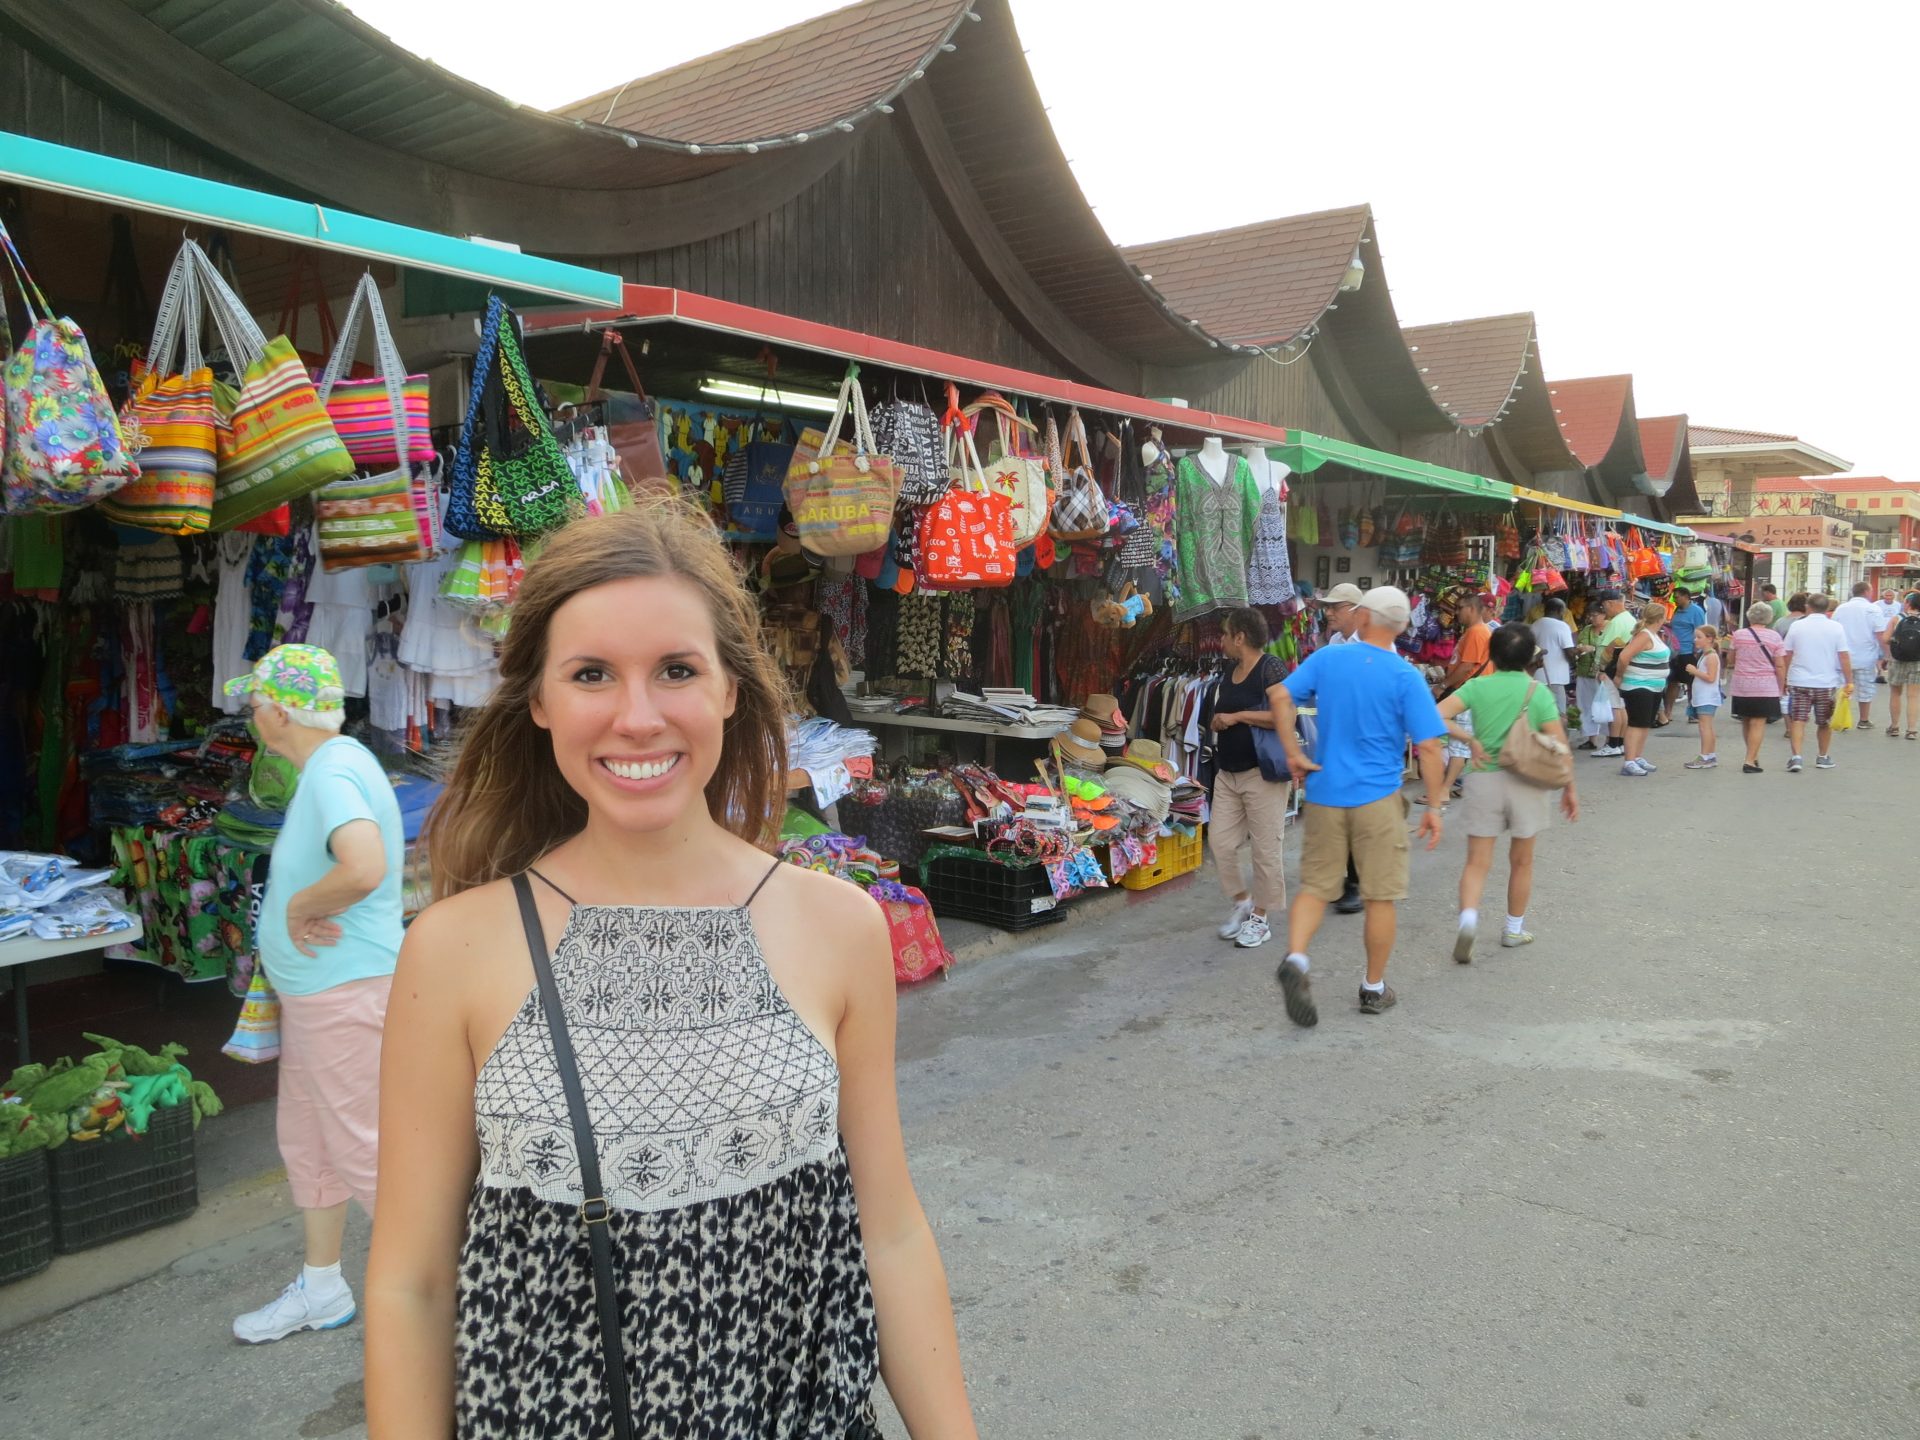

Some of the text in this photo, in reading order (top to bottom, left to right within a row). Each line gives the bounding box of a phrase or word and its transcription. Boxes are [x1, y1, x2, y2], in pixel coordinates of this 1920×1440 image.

[921, 434, 937, 491] ARUBA
[521, 480, 559, 505] ARUBA
[807, 503, 870, 521] ARUBA
[1762, 524, 1820, 536] Jewels
[1761, 537, 1820, 546] & time
